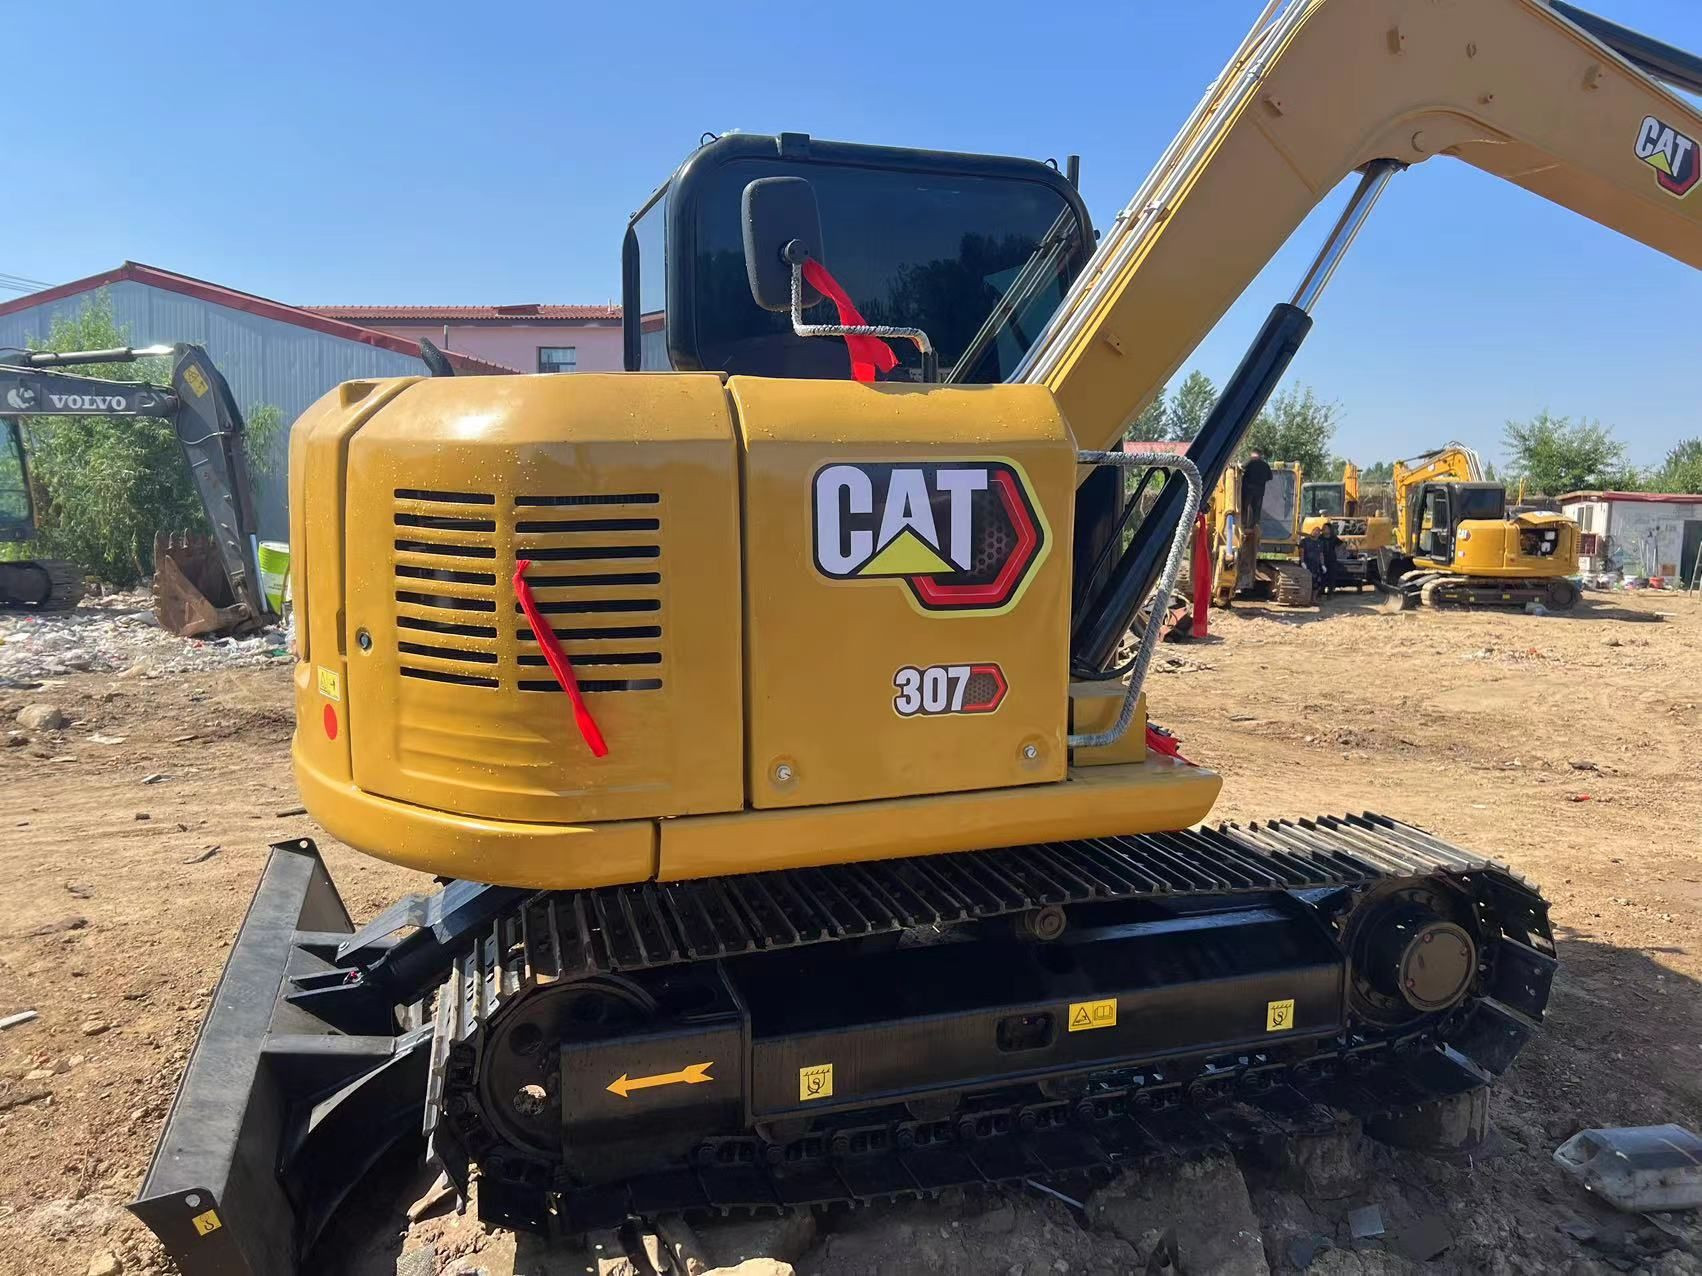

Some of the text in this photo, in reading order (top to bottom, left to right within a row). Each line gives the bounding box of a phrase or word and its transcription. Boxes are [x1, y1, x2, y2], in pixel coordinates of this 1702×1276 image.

[1635, 116, 1692, 177] CAT
[49, 394, 126, 410] VOLVO
[816, 465, 988, 575] CAT
[895, 666, 971, 714] 307
